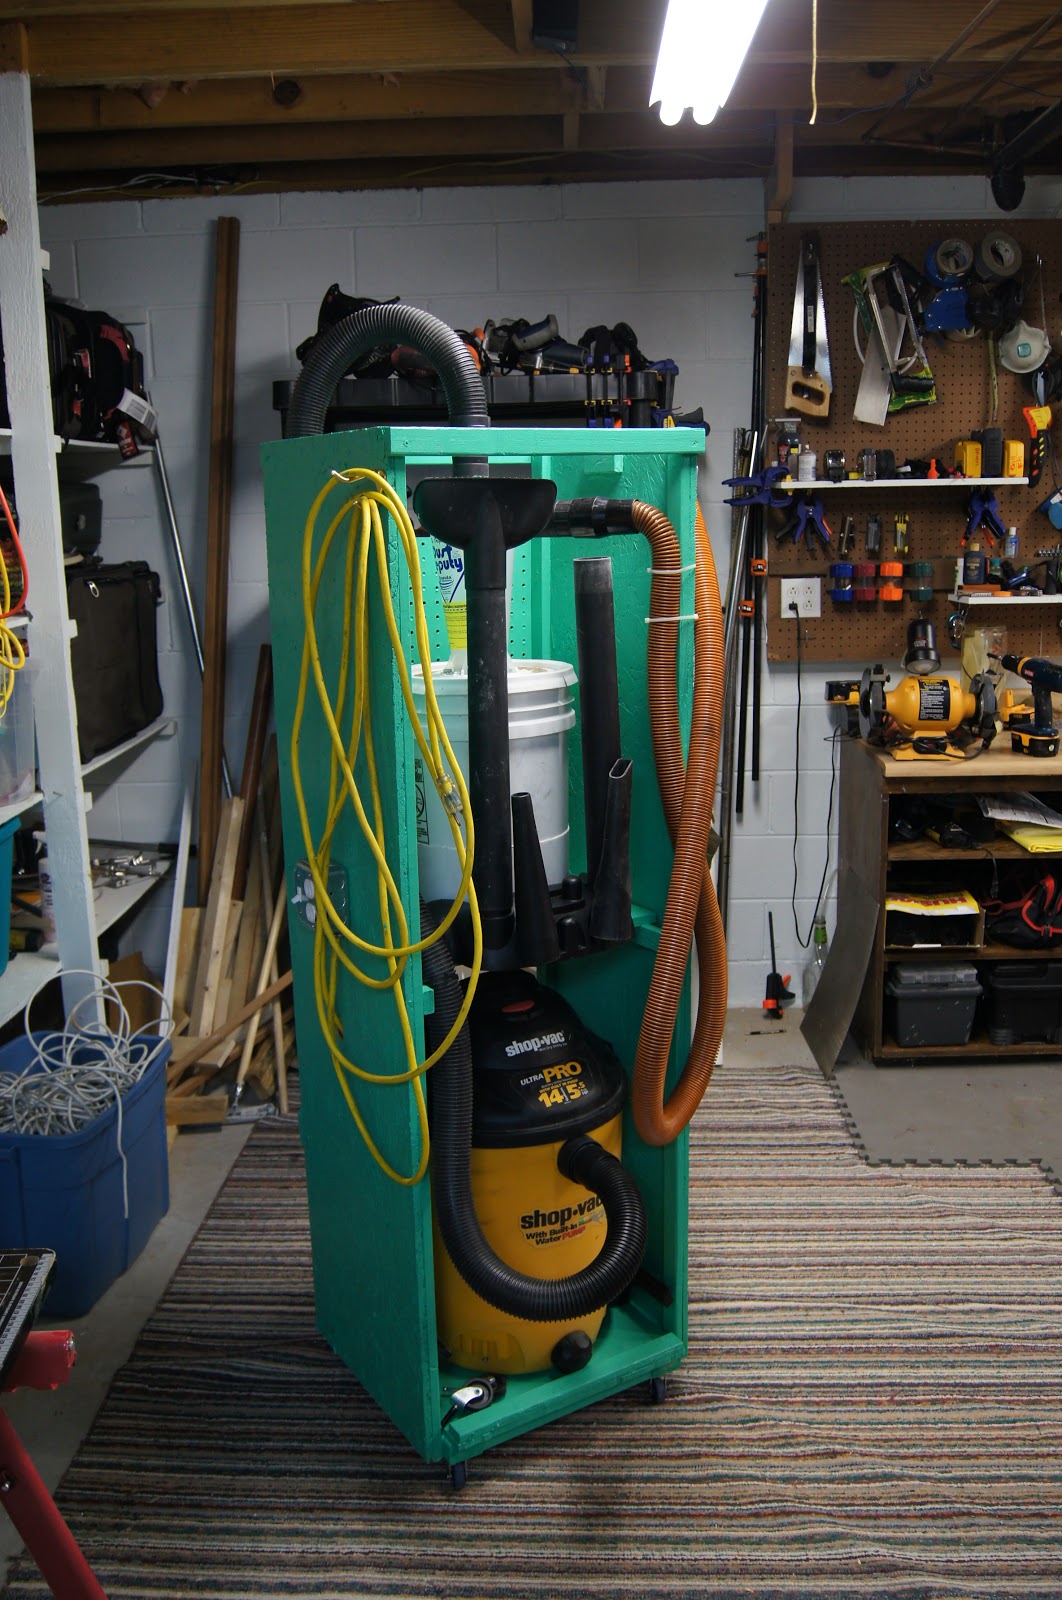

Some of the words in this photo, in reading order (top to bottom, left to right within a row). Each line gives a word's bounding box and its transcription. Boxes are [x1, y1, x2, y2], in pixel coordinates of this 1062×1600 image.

[435, 557, 463, 574] puty
[520, 1073, 544, 1086] ULTRA
[542, 1061, 582, 1083] PRO
[538, 1088, 564, 1108] 14
[525, 1231, 548, 1240] With
[549, 1223, 578, 1236] Built-In
[535, 1235, 562, 1245] Water
[562, 1225, 586, 1240] PUMP
